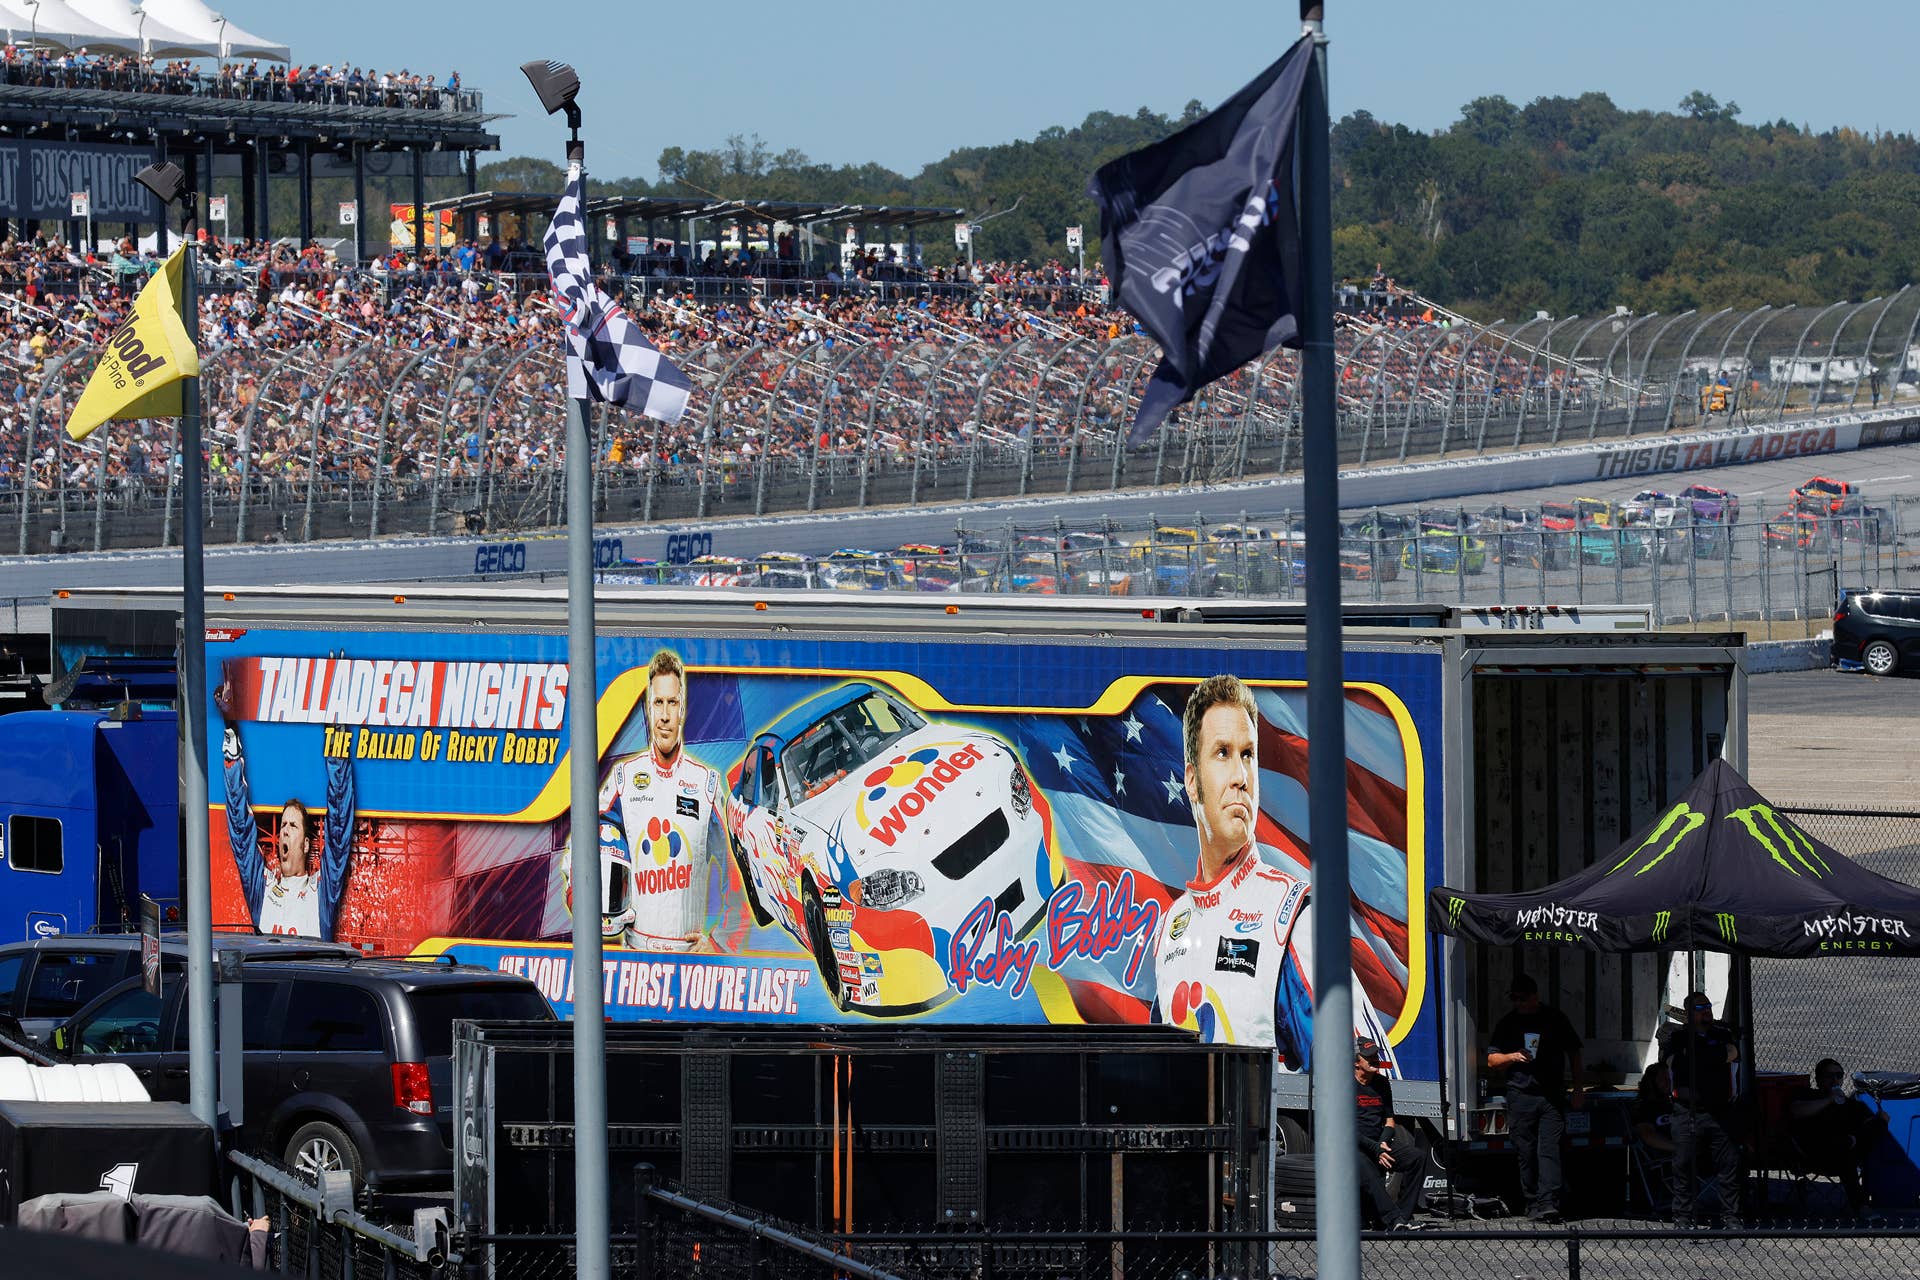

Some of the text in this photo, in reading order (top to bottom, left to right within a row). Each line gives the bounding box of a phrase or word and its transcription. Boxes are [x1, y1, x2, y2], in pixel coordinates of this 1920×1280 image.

[31, 150, 93, 211] BUSCH
[94, 152, 152, 216] LIGHT
[105, 359, 126, 389] Pine
[1597, 449, 1650, 476] THIS
[1654, 444, 1678, 470] IS
[1682, 427, 1836, 468] TALLADEGA
[474, 543, 526, 573] GEICO
[667, 532, 712, 564] GEICO
[257, 657, 569, 730] TALLADEGA NIGHTS
[324, 727, 560, 764] THE BALLAD OF RICKY BOBBY
[869, 743, 985, 847] wonder
[635, 859, 693, 896] wonder
[826, 908, 852, 922] MOOG
[948, 868, 1160, 1000] Ricky Bobby
[1525, 932, 1583, 942] ENERGY
[1820, 941, 1894, 950] ENERGY
[837, 951, 854, 961] COMP
[528, 958, 566, 1002] YOU
[618, 962, 675, 1012] FIRST,
[680, 964, 747, 1012] YOU’RE
[863, 980, 878, 997] WIX
[101, 1163, 139, 1201] 1
[1423, 1175, 1448, 1188] Grea
